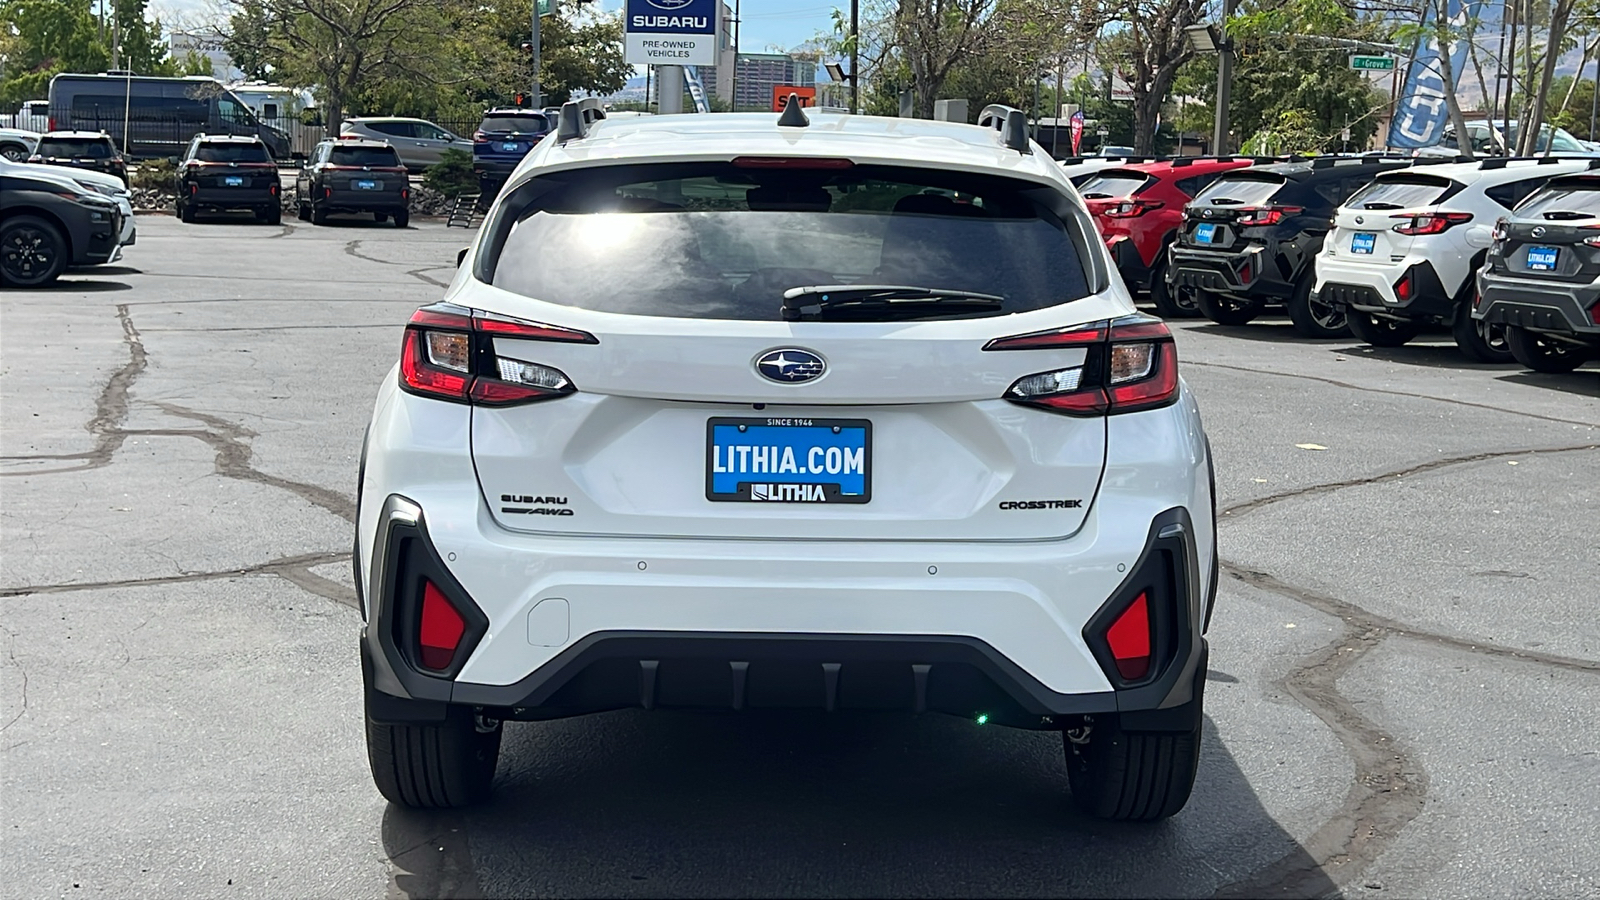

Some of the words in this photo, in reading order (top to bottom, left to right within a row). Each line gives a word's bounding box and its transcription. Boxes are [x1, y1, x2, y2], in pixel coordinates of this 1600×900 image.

[632, 15, 708, 28] SUBARU
[642, 40, 696, 49] PRE-OWNED
[647, 50, 690, 58] VEHICLES
[1365, 59, 1385, 69] Grove
[767, 418, 792, 426] SINCE
[794, 419, 813, 427] 1946
[713, 445, 865, 475] LITHIA.COM
[768, 484, 826, 501] LITHIA
[501, 494, 568, 504] SUBARU
[999, 499, 1082, 510] CROSSTREK
[528, 508, 574, 516] AWD
